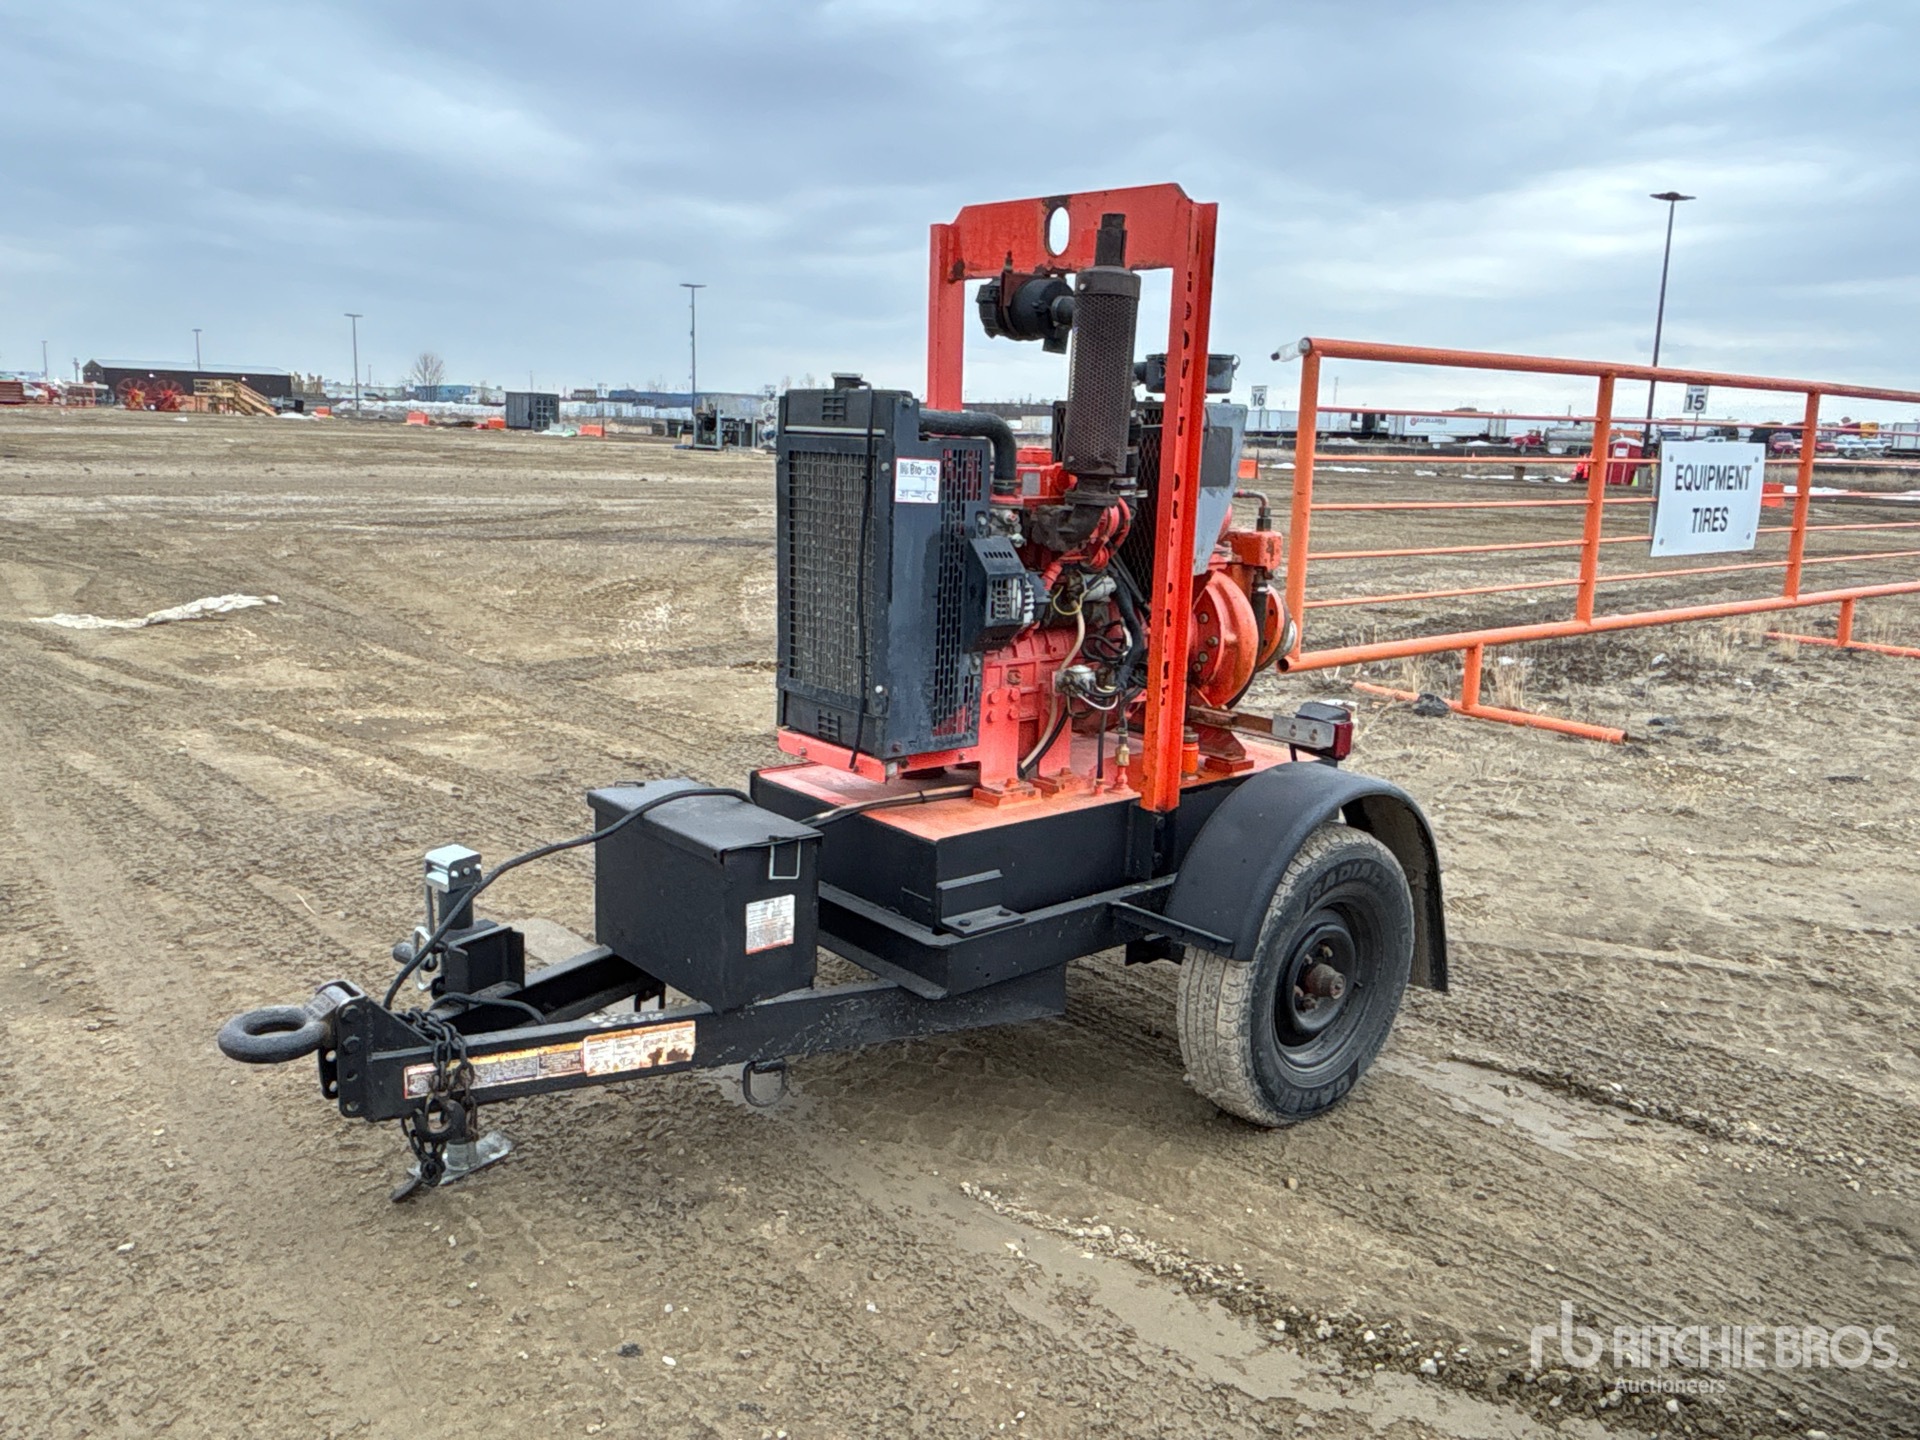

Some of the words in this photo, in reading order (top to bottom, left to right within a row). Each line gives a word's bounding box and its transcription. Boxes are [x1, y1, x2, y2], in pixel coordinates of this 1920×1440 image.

[1253, 393, 1264, 406] 16
[1687, 394, 1705, 411] 15
[1675, 464, 1752, 491] EQUIPMENT
[1692, 507, 1729, 533] TIRES
